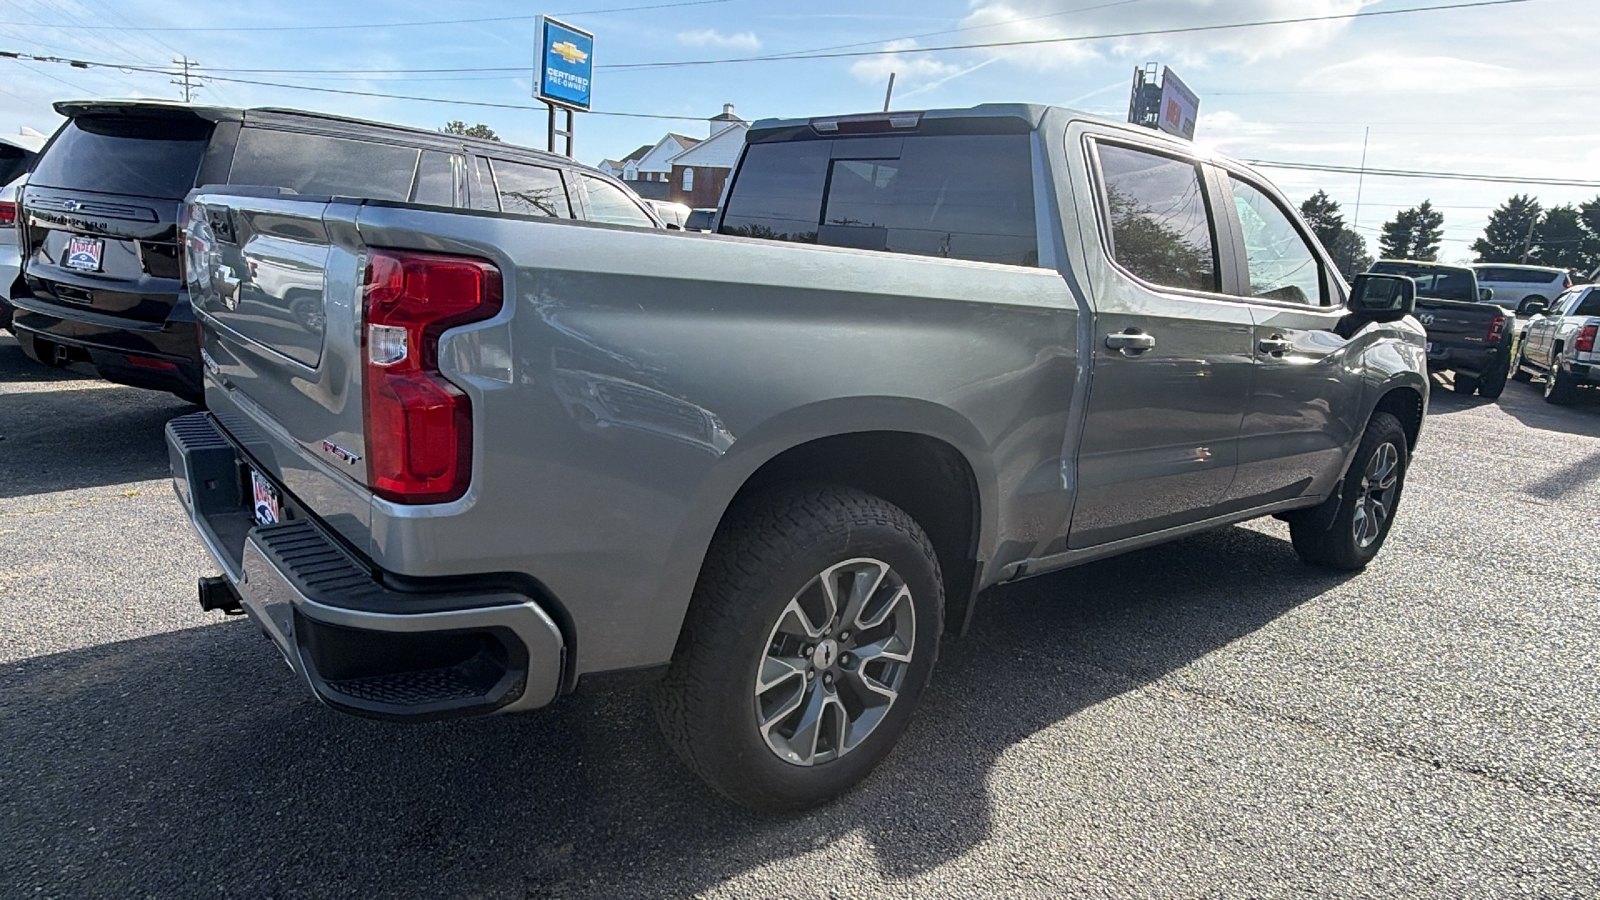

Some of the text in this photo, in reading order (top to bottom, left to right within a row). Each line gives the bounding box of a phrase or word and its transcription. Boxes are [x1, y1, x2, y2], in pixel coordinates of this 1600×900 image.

[547, 67, 588, 86] CERTIFIED
[549, 76, 586, 92] PRE-OWNED
[71, 240, 99, 259] ANDEAN
[322, 440, 362, 465] RST
